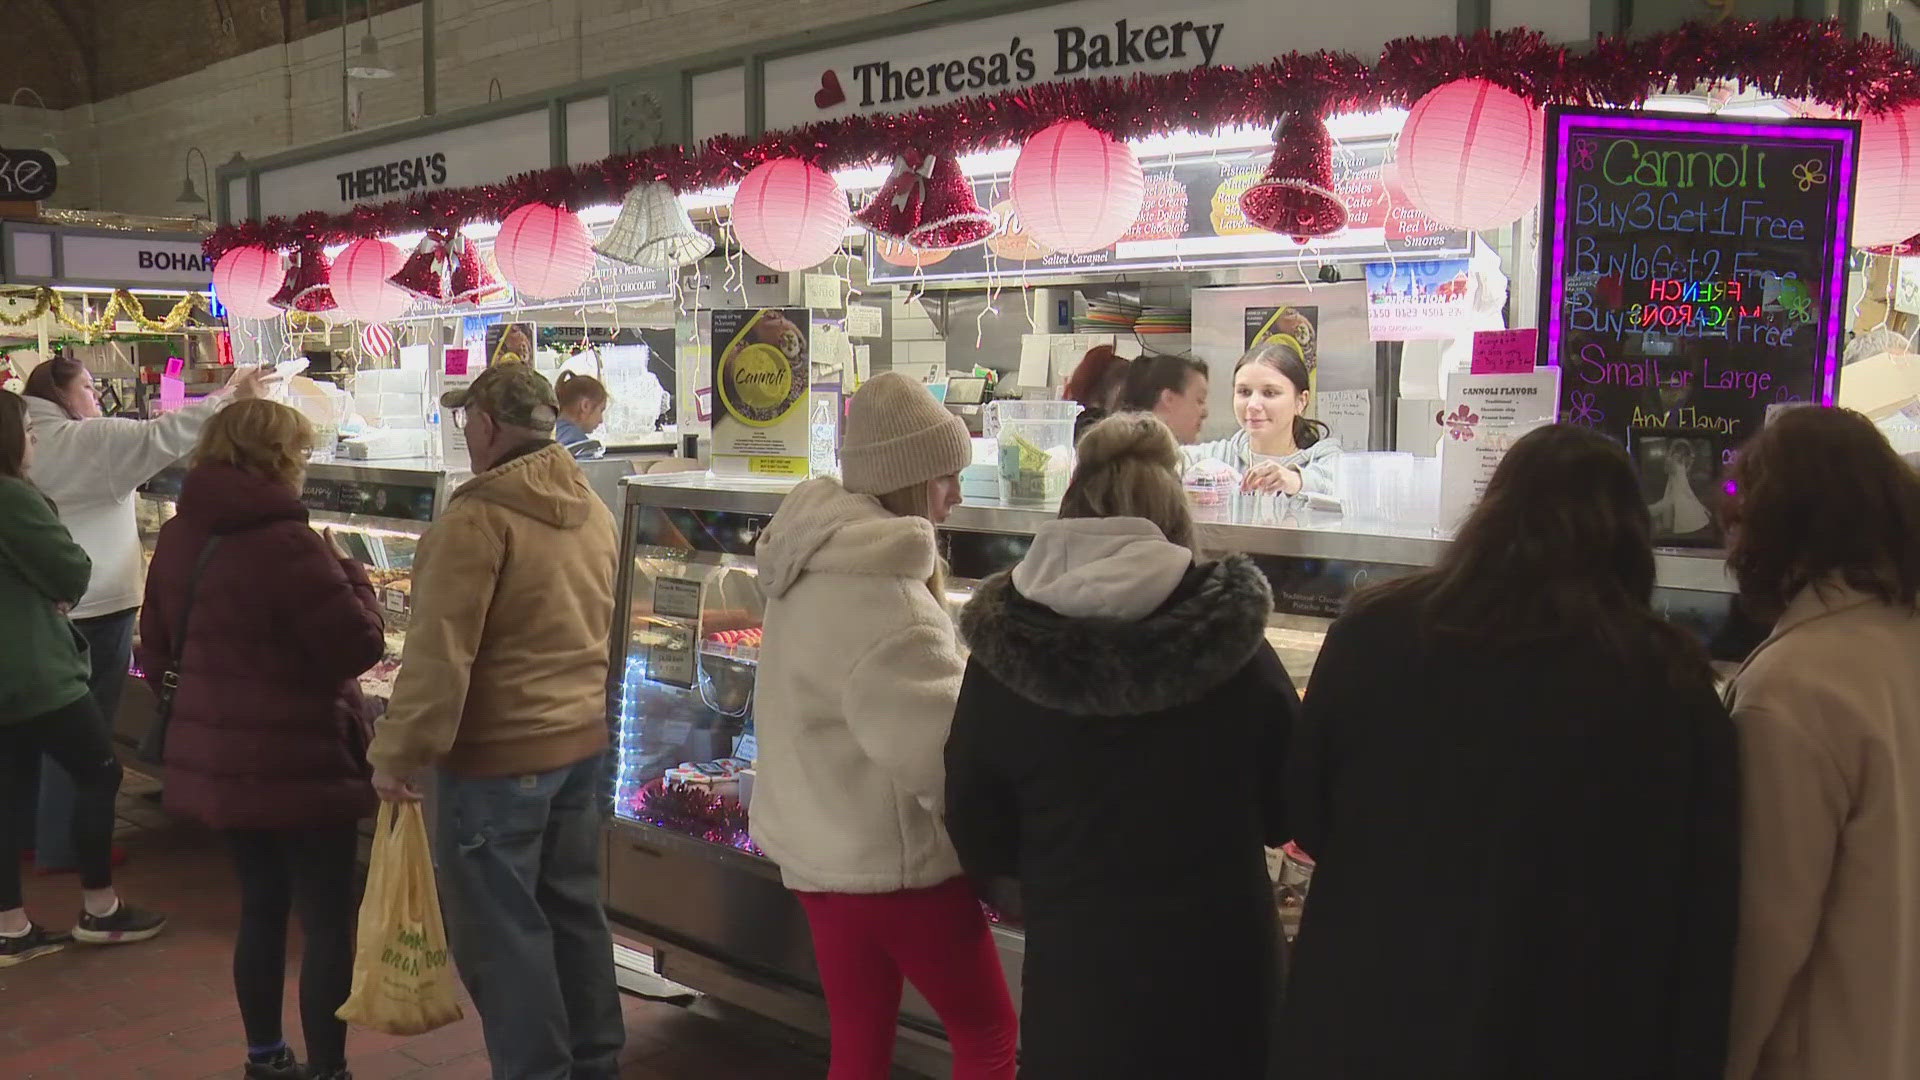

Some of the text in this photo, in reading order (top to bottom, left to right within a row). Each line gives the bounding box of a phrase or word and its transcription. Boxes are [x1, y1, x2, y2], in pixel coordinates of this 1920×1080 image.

[853, 18, 1225, 107] Theresa's Bakery
[1602, 139, 1766, 188] Cannoli
[337, 152, 447, 202] THERESA'S
[1157, 195, 1188, 208] Cream
[1156, 206, 1187, 221] Dough
[1739, 200, 1806, 241] Free
[1143, 221, 1190, 234] Chocolate
[1398, 220, 1420, 234] Red
[1404, 234, 1446, 248] Smores
[1042, 250, 1109, 266] Salted Caramel
[1733, 252, 1799, 289] Free
[620, 280, 657, 293] CHOCOLATE
[1736, 312, 1797, 347] Free
[735, 367, 787, 386] Cannoli
[1579, 343, 1660, 388] Small
[1703, 358, 1773, 399] Large
[1462, 386, 1538, 396] CANNOLI FLAVORS
[1678, 405, 1741, 435] Flavor
